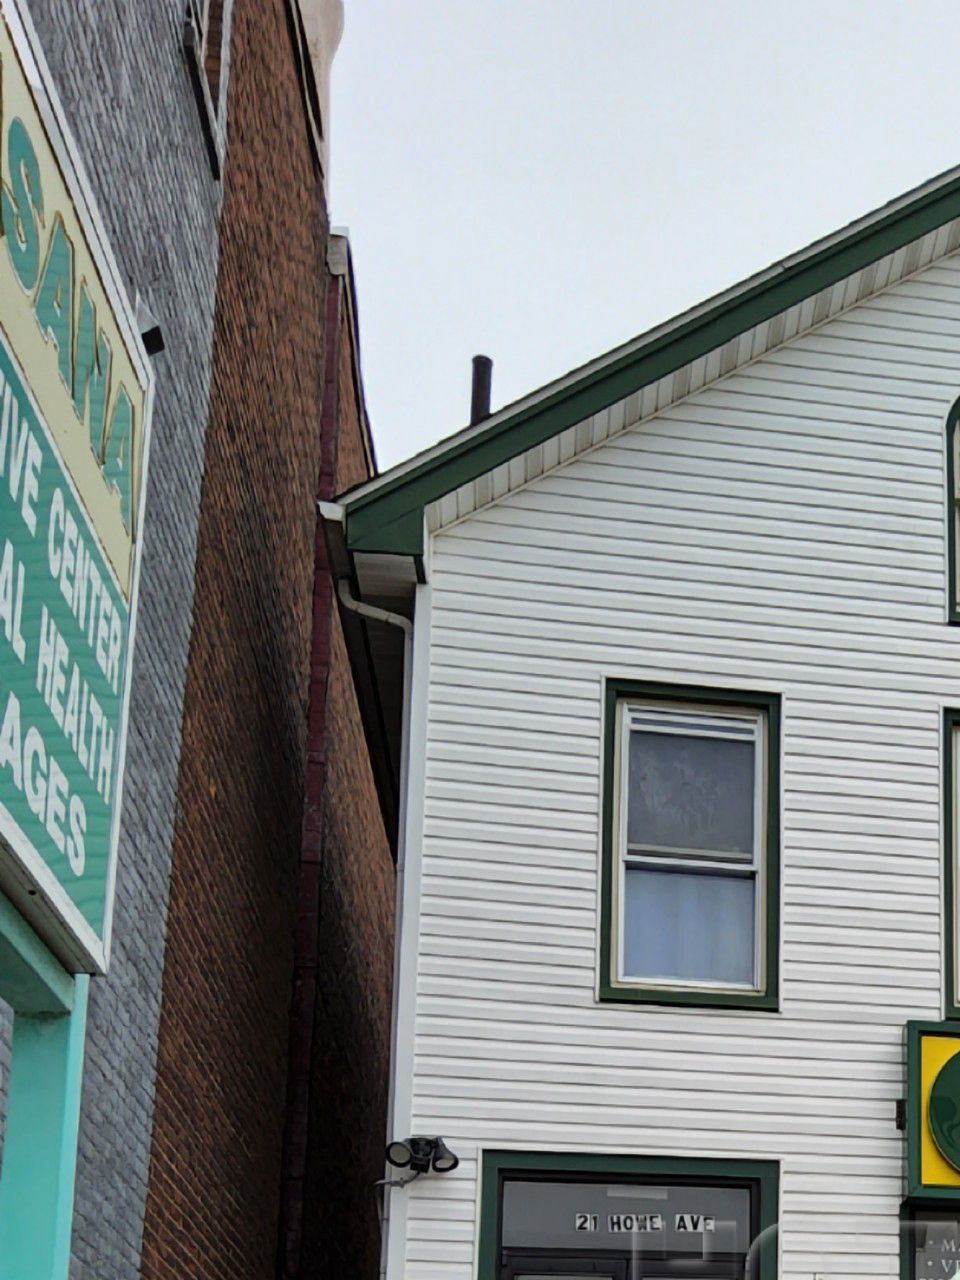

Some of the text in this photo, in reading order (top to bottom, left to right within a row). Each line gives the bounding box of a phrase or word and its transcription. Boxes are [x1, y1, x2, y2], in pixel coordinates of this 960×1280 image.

[0, 115, 133, 537] SANA
[0, 370, 121, 695] IVE CENTER
[36, 602, 113, 804] HEALTH
[577, 1215, 715, 1232] 21 HOWE AVE
